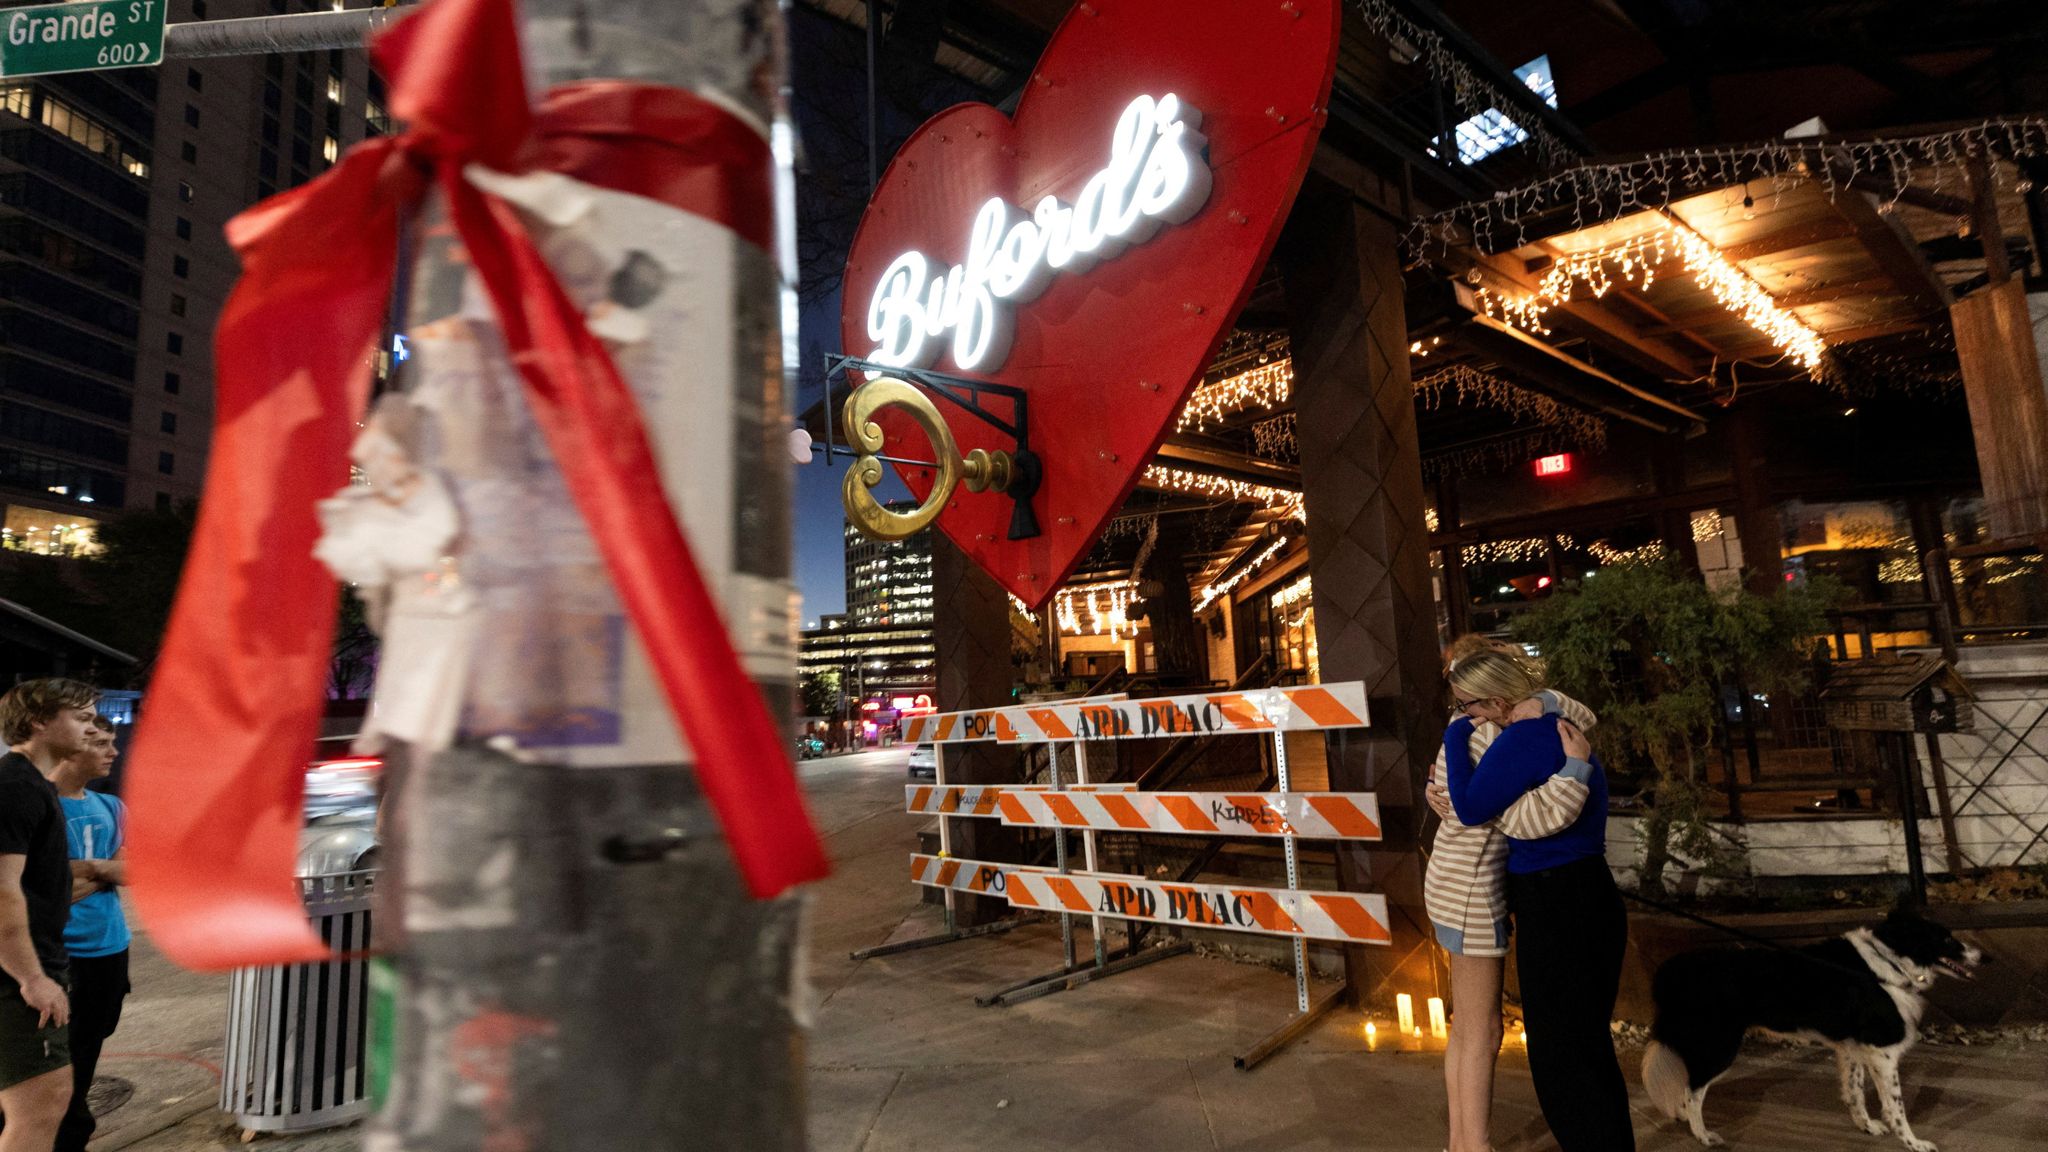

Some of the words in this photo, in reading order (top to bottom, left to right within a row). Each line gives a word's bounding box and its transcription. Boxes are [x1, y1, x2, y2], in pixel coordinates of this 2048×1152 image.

[9, 6, 116, 46] Grande
[128, 2, 154, 23] ST
[97, 43, 135, 65] 600
[865, 93, 1189, 380] Buford's
[964, 716, 995, 737] POL
[1075, 708, 1130, 738] APD
[1140, 702, 1223, 734] DTAC
[1099, 885, 1156, 917] APD
[1167, 889, 1255, 928] DTAC
